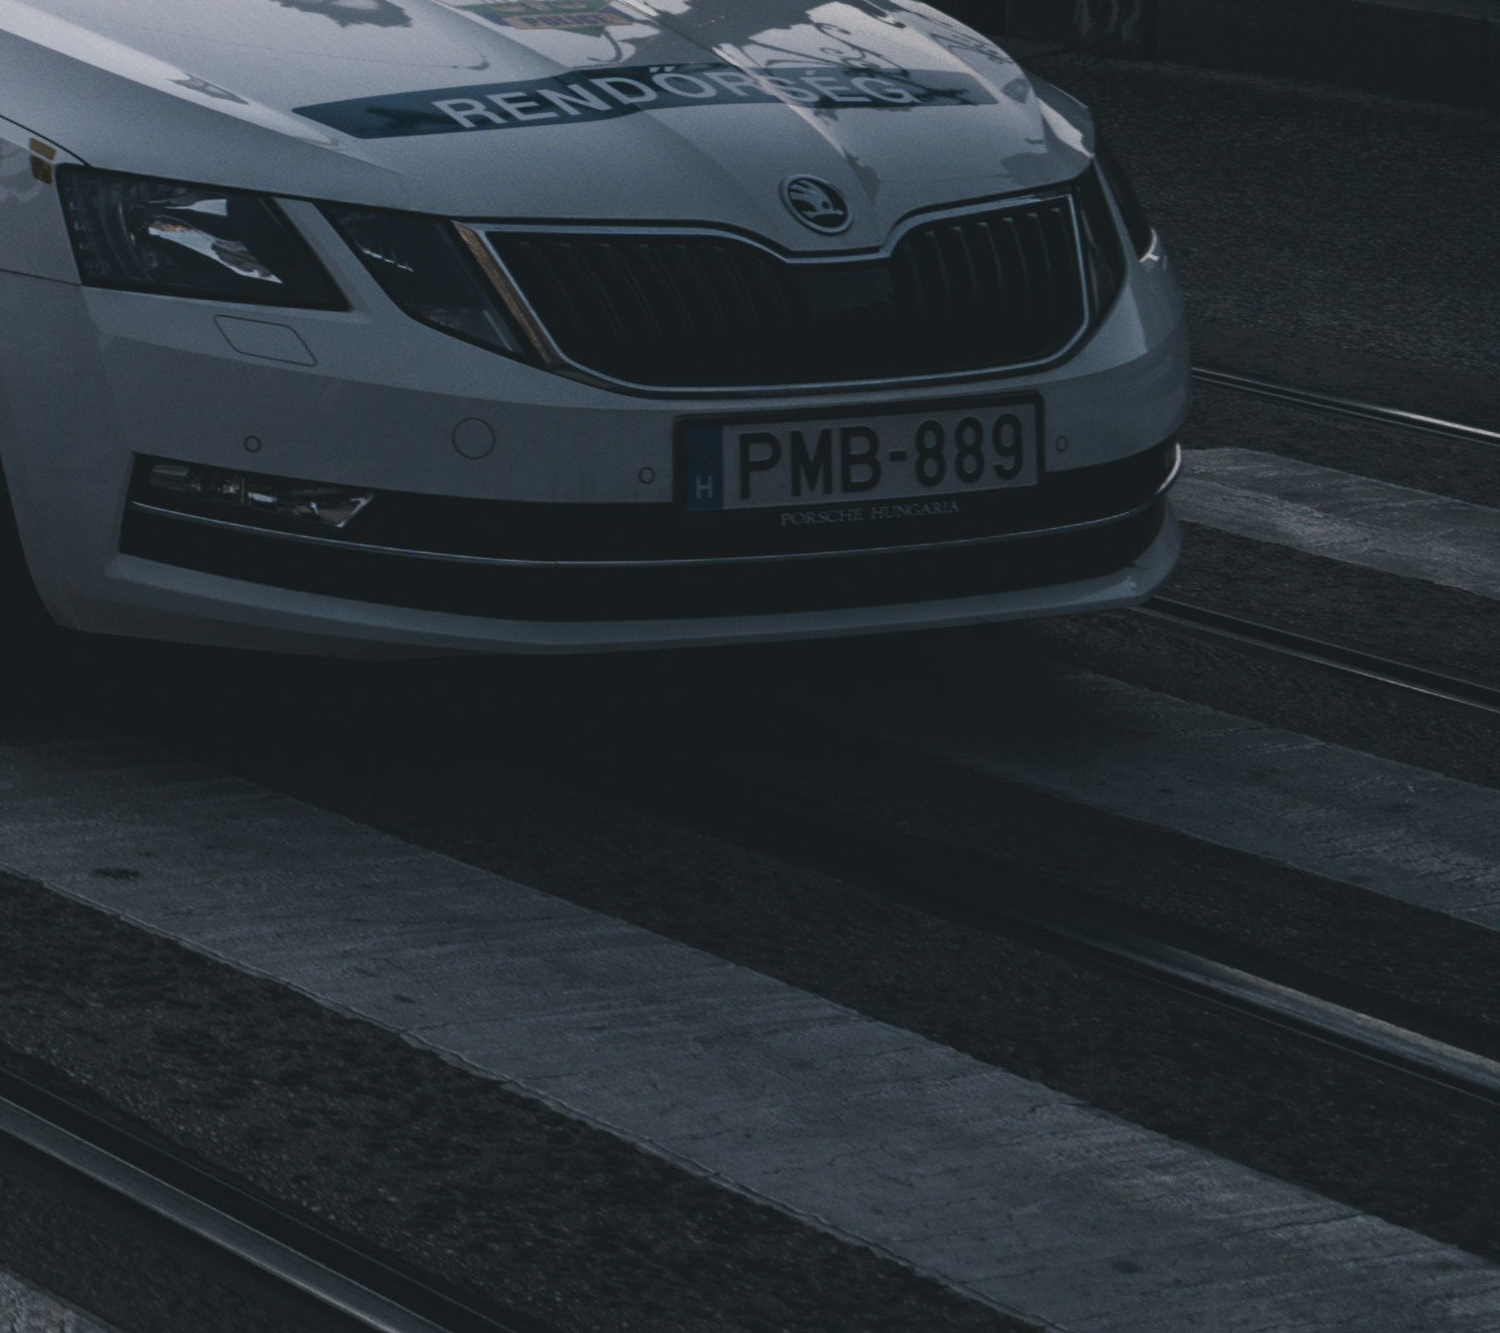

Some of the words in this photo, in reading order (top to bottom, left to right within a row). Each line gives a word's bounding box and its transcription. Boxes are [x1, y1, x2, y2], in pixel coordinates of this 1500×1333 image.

[432, 64, 924, 129] RENDŐRSÉG
[694, 475, 714, 501] H
[739, 412, 1024, 501] PMB-889
[780, 508, 865, 527] PORSCHE
[870, 500, 961, 521] HUNGARIA
